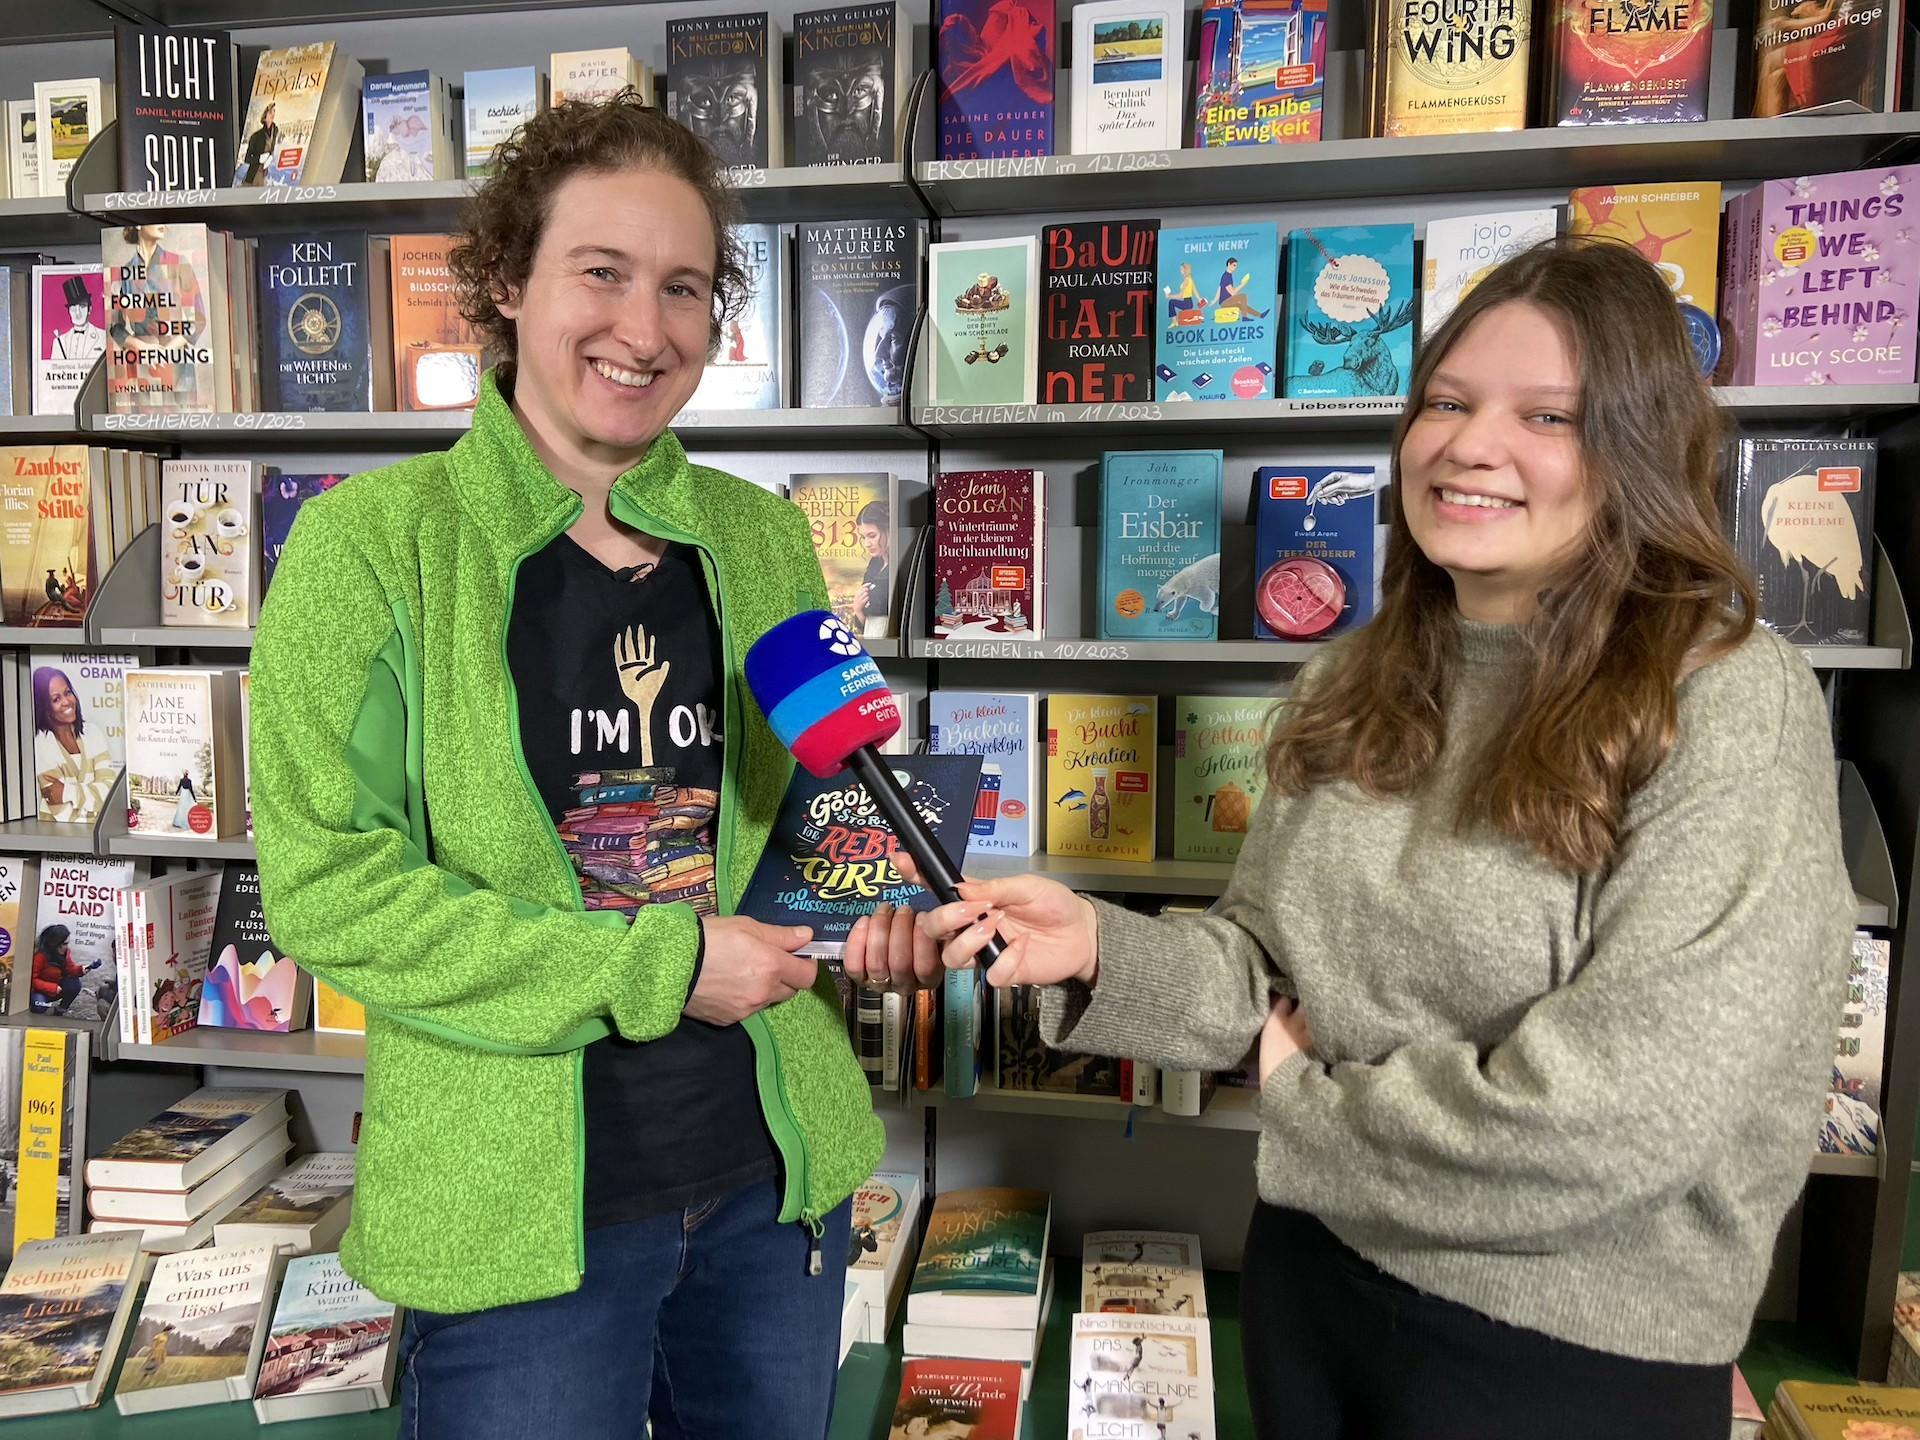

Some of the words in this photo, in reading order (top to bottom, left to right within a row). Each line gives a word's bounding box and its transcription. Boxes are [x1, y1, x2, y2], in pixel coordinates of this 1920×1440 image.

[1590, 5, 1689, 33] FLAME
[1755, 7, 1882, 50] Mittsommertage
[672, 30, 763, 64] KINGDOM
[799, 21, 893, 59] KINGDOM
[1403, 25, 1516, 63] WING
[1812, 44, 1846, 58] C.H.Beck
[139, 34, 217, 101] LICHT
[569, 67, 618, 79] SAFIER
[255, 67, 322, 100] Eispalast
[1583, 79, 1688, 93] FLAMMENGEKÜSST
[1103, 87, 1151, 99] Bernhard
[488, 104, 520, 117] tschick
[1107, 97, 1147, 109] Schlink
[1408, 96, 1506, 110] FLAMMENGEKÜSST
[136, 106, 168, 117] DANIEL
[171, 109, 224, 121] KEHLMANN
[944, 114, 989, 124] SABINE
[996, 111, 1045, 121] GRUBER
[1116, 110, 1137, 120] Das
[1206, 107, 1248, 125] Eine
[1254, 98, 1311, 119] halbe
[944, 133, 973, 145] DIE
[984, 129, 1045, 142] DAUER
[1225, 119, 1310, 144] Ewigkeit
[927, 158, 1047, 180] ERSCHIENEN
[1088, 153, 1172, 174] 12/2023
[1599, 195, 1640, 206] JASMIN
[1641, 191, 1701, 204] SCHREIBER
[1785, 194, 1905, 226] THINGS
[808, 225, 906, 243] MATTHIAS
[1473, 222, 1511, 245] jojo
[291, 242, 332, 263] KEN
[817, 240, 896, 255] MAURER
[1184, 242, 1213, 254] EMILY
[1218, 239, 1250, 252] HENRY
[1818, 232, 1867, 257] WE
[402, 252, 441, 262] JOCHEN
[121, 265, 146, 281] DIE
[401, 267, 416, 277] ZU
[419, 266, 450, 277] HAUSE
[811, 262, 865, 273] COSMIC
[871, 261, 902, 271] KISS
[269, 263, 356, 289] FOLLETT
[1048, 275, 1088, 289] PAUL
[1091, 271, 1153, 286] AUSTER
[1323, 271, 1347, 281] Jonas
[1348, 272, 1387, 286] Jonasson
[1802, 265, 1880, 294] LEFT
[1350, 285, 1378, 296] Schweden
[110, 292, 176, 310] FORMEL
[408, 297, 442, 307] Schmidt
[1783, 301, 1896, 328] BEHIND
[158, 320, 191, 336] DER
[1165, 329, 1205, 345] BOOK
[1210, 326, 1264, 342] LOVERS
[113, 348, 209, 366] HOFFNUNG
[1068, 343, 1130, 359] ROMAN
[1183, 348, 1197, 358] Die
[1198, 347, 1216, 357] Liebe
[1218, 346, 1245, 356] steckt
[1770, 349, 1822, 368] LUCY
[1829, 346, 1902, 365] SCORE
[293, 360, 338, 372] WAFFEN
[1176, 356, 1210, 367] zwischen
[1228, 354, 1253, 365] Zeilen
[45, 372, 79, 381] Arsène
[297, 373, 336, 385] LICHTS
[115, 385, 136, 393] LYNN
[139, 384, 173, 393] CULLEN
[921, 408, 1039, 424] ERSCHIENEN
[1078, 404, 1162, 422] 11/2023
[1784, 442, 1875, 452] POLLATSCHEK
[14, 456, 82, 477] Zauber
[165, 463, 210, 473] DOMINIK
[214, 462, 248, 473] BARTA
[1146, 462, 1178, 474] John
[51, 478, 82, 496] der
[960, 479, 1008, 501] Jenny
[1121, 475, 1200, 489] Ironmonger
[179, 478, 229, 503] TÜR
[798, 486, 860, 501] SABINE
[37, 499, 86, 519] Stille
[799, 500, 859, 517] EBERT
[943, 497, 1025, 514] COLGAN
[1147, 494, 1177, 509] Der
[1787, 501, 1835, 511] KLEINE
[948, 518, 1018, 532] Winterträume
[1118, 511, 1203, 540] Eisbär
[1776, 517, 1846, 527] PROBLEME
[810, 519, 858, 549] 813
[964, 534, 979, 543] der
[980, 533, 1014, 543] kleinen
[939, 544, 1029, 559] Buchhandlung
[1137, 542, 1160, 553] und
[1162, 542, 1181, 553] die
[1305, 541, 1327, 549] DER
[1121, 553, 1176, 567] Hoffnung
[1178, 552, 1197, 565] auf
[176, 582, 225, 607] TÜR
[924, 641, 1022, 658] ERSCHIENEN
[1054, 643, 1129, 660] 10/2023
[62, 653, 132, 665] MICHELLE
[80, 667, 122, 679] OBAM
[149, 694, 185, 709] JANE
[139, 709, 197, 725] AUSTEN
[951, 709, 973, 723] Die
[975, 705, 1007, 718] kleine
[1066, 709, 1089, 722] Die
[1208, 712, 1232, 727] Das
[570, 708, 630, 755] I'M
[669, 702, 725, 748] OK
[942, 719, 1023, 745] Bäckerei
[1074, 718, 1139, 745] Bucht
[961, 737, 1024, 757] Brooklyn
[1064, 748, 1140, 771] Kroatien
[816, 826, 901, 863] REBE
[978, 839, 1019, 849] CAPLIN
[1059, 842, 1091, 852] JULIE
[1096, 843, 1139, 855] CAPLIN
[50, 867, 89, 881] NACH
[44, 881, 114, 903] DEUTSC
[774, 888, 810, 905] 100
[58, 901, 105, 917] LAND
[823, 923, 851, 933] HANSER
[27, 1099, 55, 1116] 1964
[7, 1262, 126, 1288] Sehnsucht
[176, 1269, 213, 1283] Was
[219, 1263, 252, 1277] uns
[166, 1281, 250, 1303] erinnern
[24, 1298, 85, 1320] Licht
[181, 1301, 224, 1319] lässt
[1080, 1318, 1107, 1329] Nino
[1093, 1339, 1122, 1352] DAS
[911, 1385, 941, 1396] Vom
[949, 1382, 1007, 1400] Winde
[1094, 1379, 1199, 1399] MANGELNDE
[929, 1398, 982, 1408] verweht
[1847, 1394, 1878, 1405] die
[1086, 1423, 1143, 1437] LICHT
